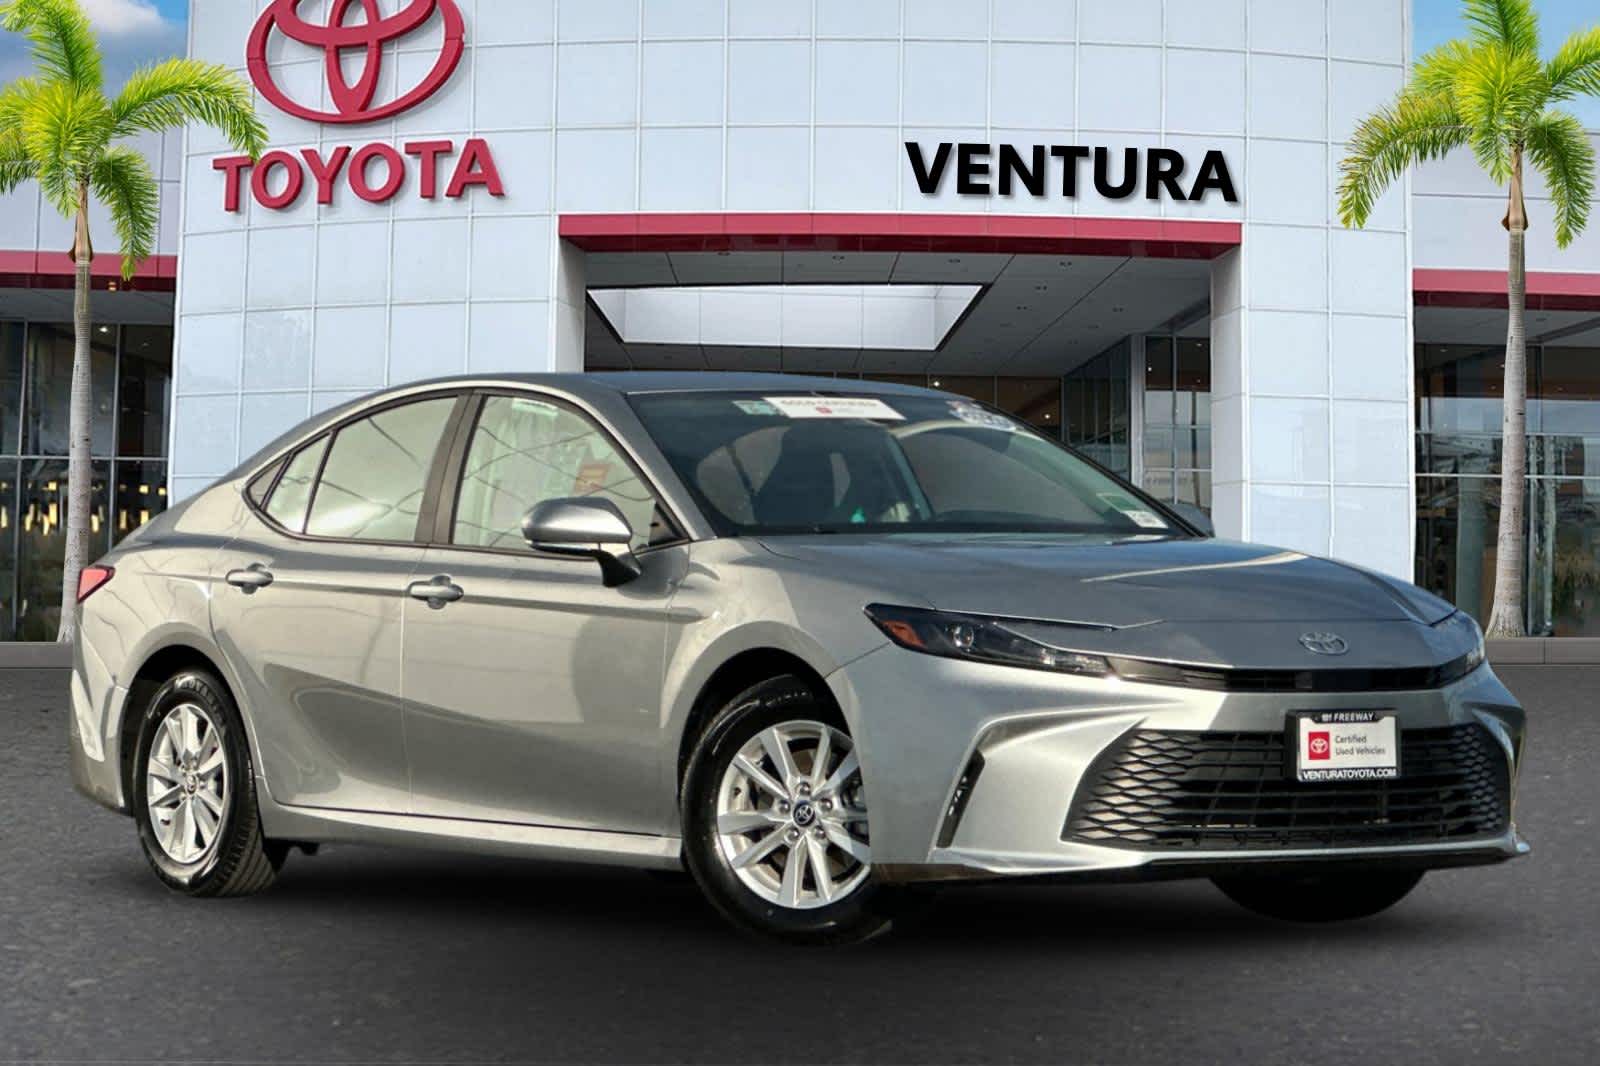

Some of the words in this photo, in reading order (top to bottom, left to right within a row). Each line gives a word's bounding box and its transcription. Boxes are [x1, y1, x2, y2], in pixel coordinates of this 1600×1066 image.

[212, 138, 505, 212] TOYOTA
[904, 142, 1239, 202] VENTURA
[1334, 712, 1374, 721] FREEWAY
[1335, 735, 1367, 744] Certified
[1335, 748, 1354, 756] Used
[1357, 747, 1386, 756] Vehicles
[1303, 768, 1397, 780] VENTURATOYOTA.COM
